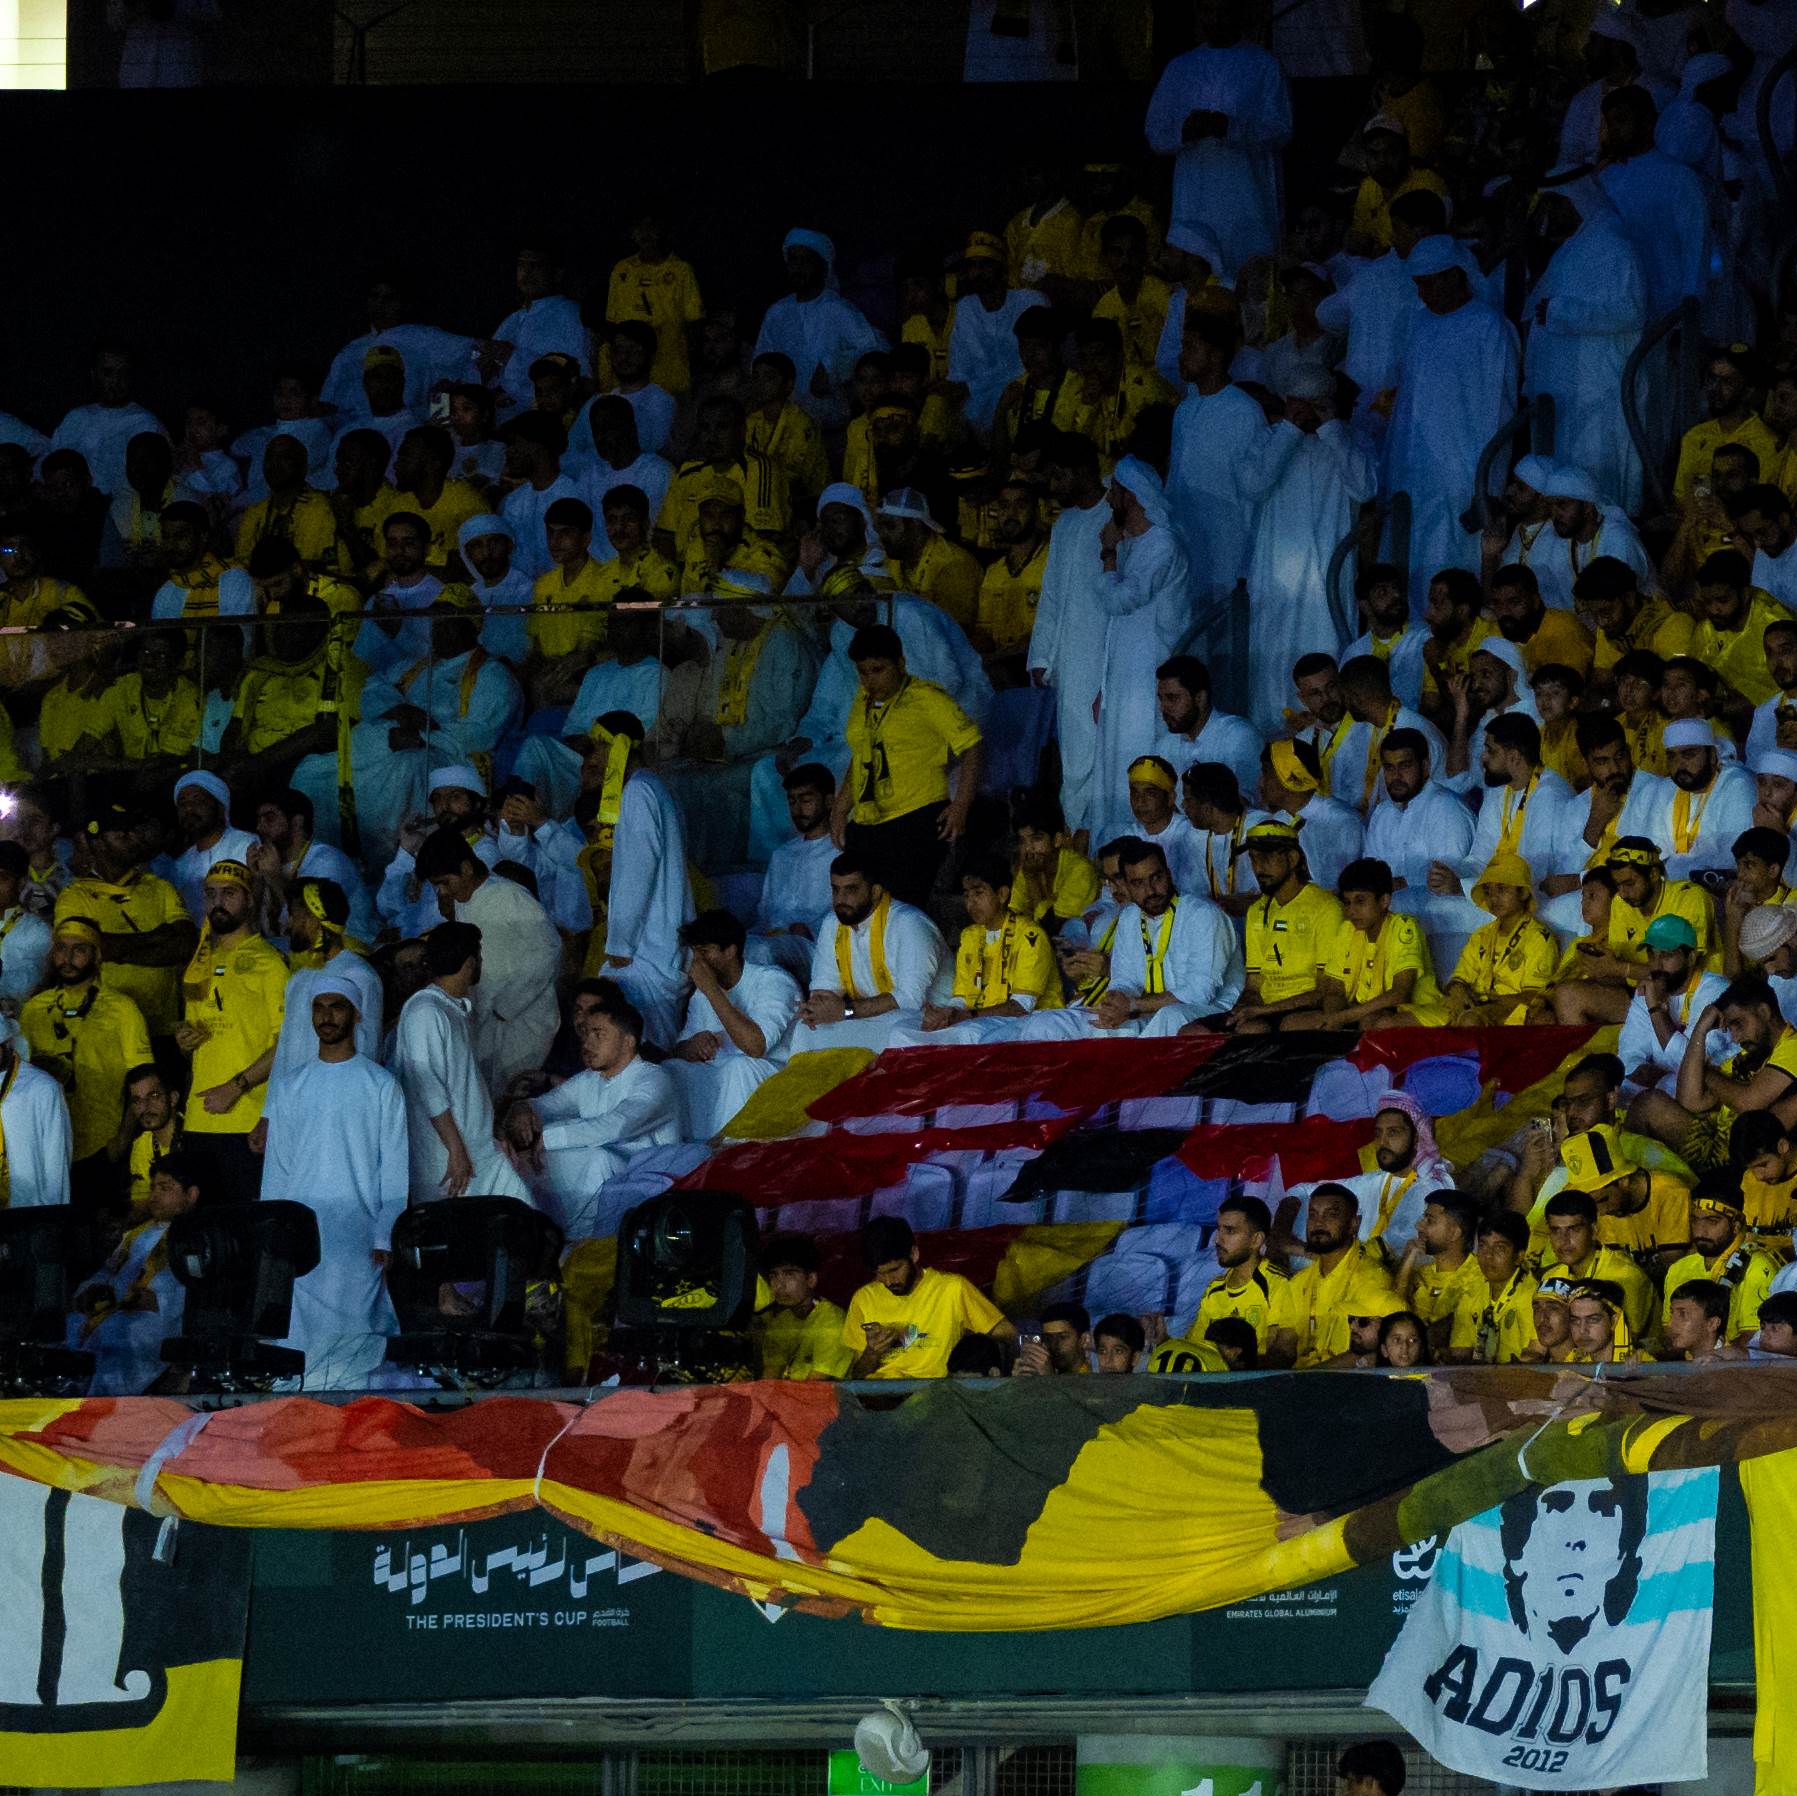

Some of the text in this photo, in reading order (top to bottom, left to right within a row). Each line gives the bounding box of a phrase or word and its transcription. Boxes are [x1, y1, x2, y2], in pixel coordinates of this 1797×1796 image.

[373, 1528, 467, 1606] الدولة
[471, 1532, 567, 1594] رئيس
[405, 1610, 588, 1629] THE PRESIDENT'S CUP
[592, 1617, 630, 1627] FOOTBALL
[1226, 1610, 1263, 1619] EMIRATES
[1264, 1608, 1294, 1618] GLOBAL
[1502, 1745, 1569, 1773] 2012
